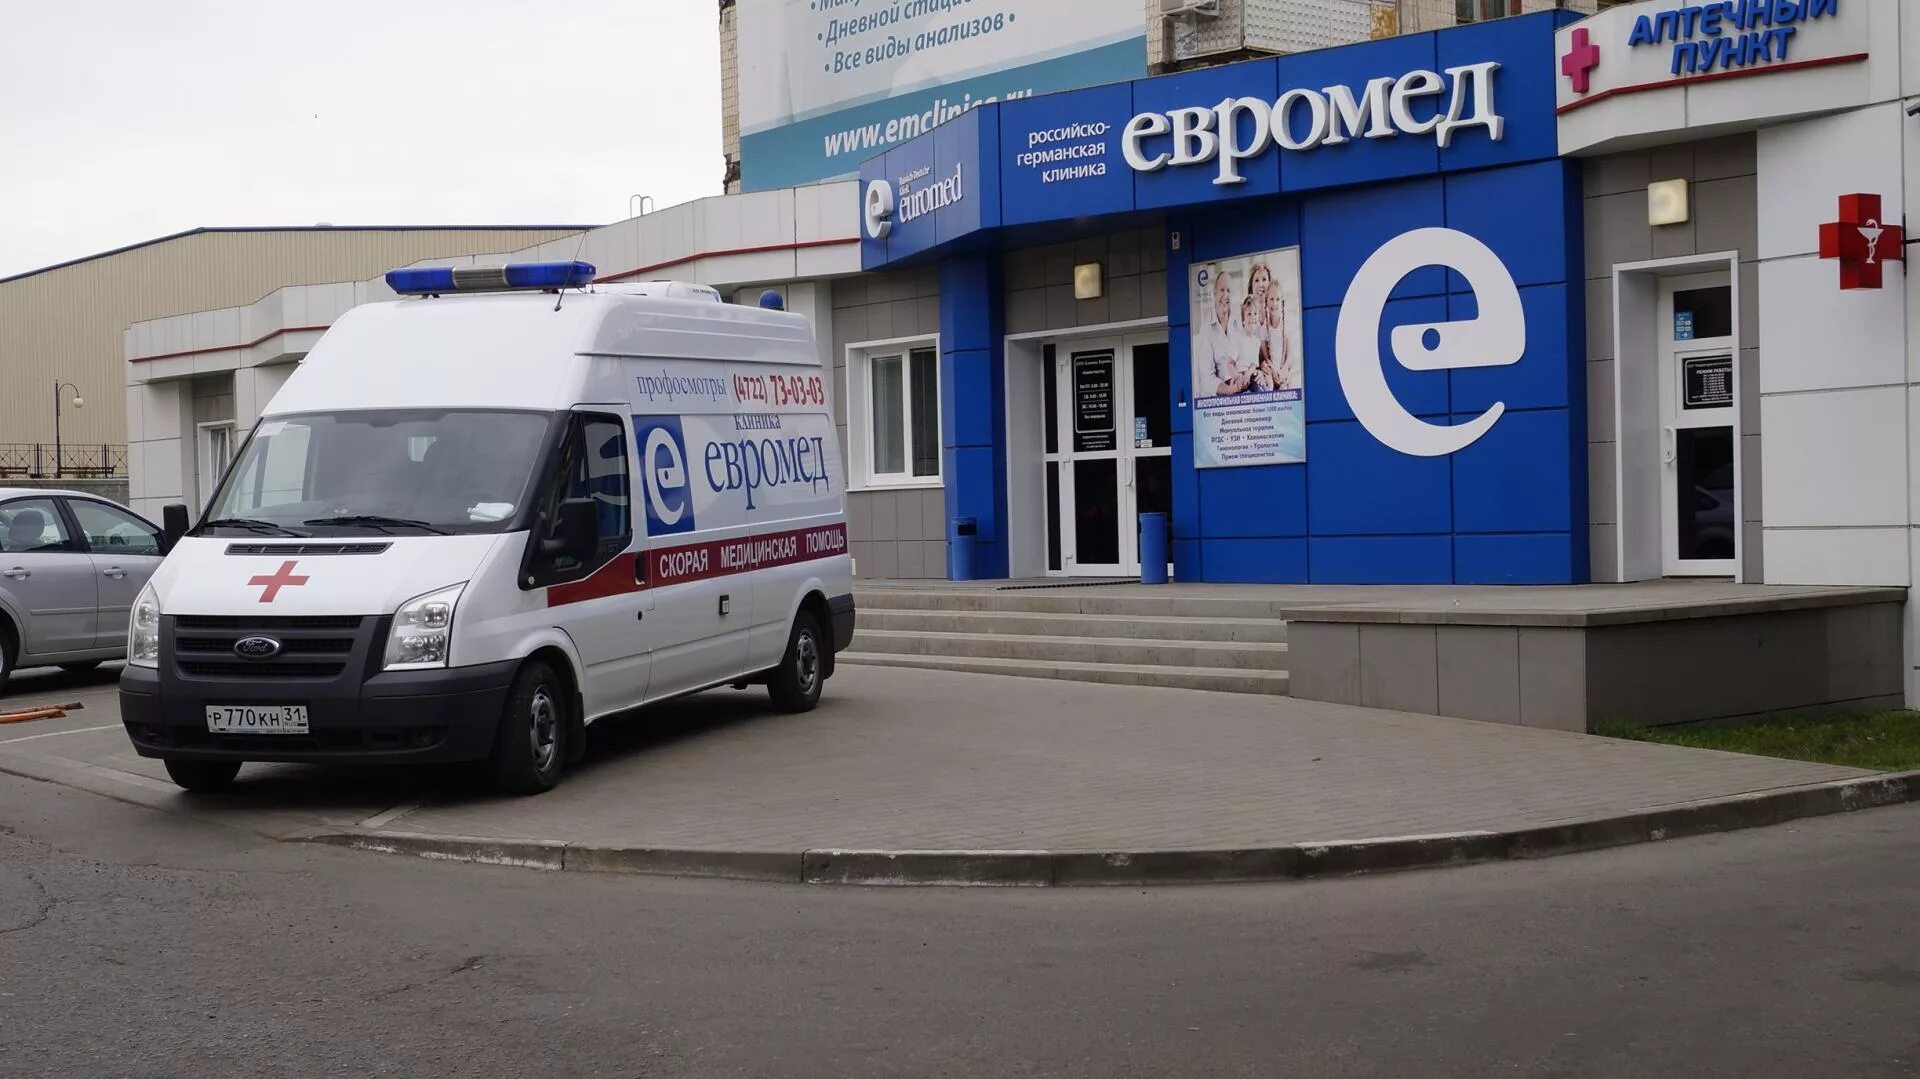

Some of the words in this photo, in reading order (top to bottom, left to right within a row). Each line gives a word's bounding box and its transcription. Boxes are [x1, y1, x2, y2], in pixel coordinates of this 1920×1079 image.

[826, 0, 900, 46] Дневной
[833, 51, 861, 73] Все
[865, 36, 911, 66] виды
[915, 12, 1004, 51] анализов
[1670, 27, 1797, 74] ПУНКТ
[1028, 122, 1111, 149] российско-
[1122, 61, 1505, 184] евромед
[1017, 142, 1106, 168] германская
[1042, 162, 1106, 183] клиника
[899, 162, 963, 223] euromed
[636, 369, 728, 401] профосмотры
[733, 373, 768, 404] (4722)
[770, 375, 825, 405] 73-03-03
[734, 413, 782, 431] клиника
[1219, 427, 1252, 435] Мануальная
[1252, 425, 1275, 433] терапия
[1221, 417, 1243, 425] Дневной
[1244, 416, 1273, 424] стационар
[1253, 443, 1279, 451] Урология
[704, 436, 830, 511] евромед
[659, 549, 709, 578] СКОРАЯ
[720, 536, 798, 570] МЕДИЦИНСКАЯ
[805, 528, 845, 553] ПОМОЩЬ
[242, 640, 269, 652] Ford
[284, 708, 301, 720] 31
